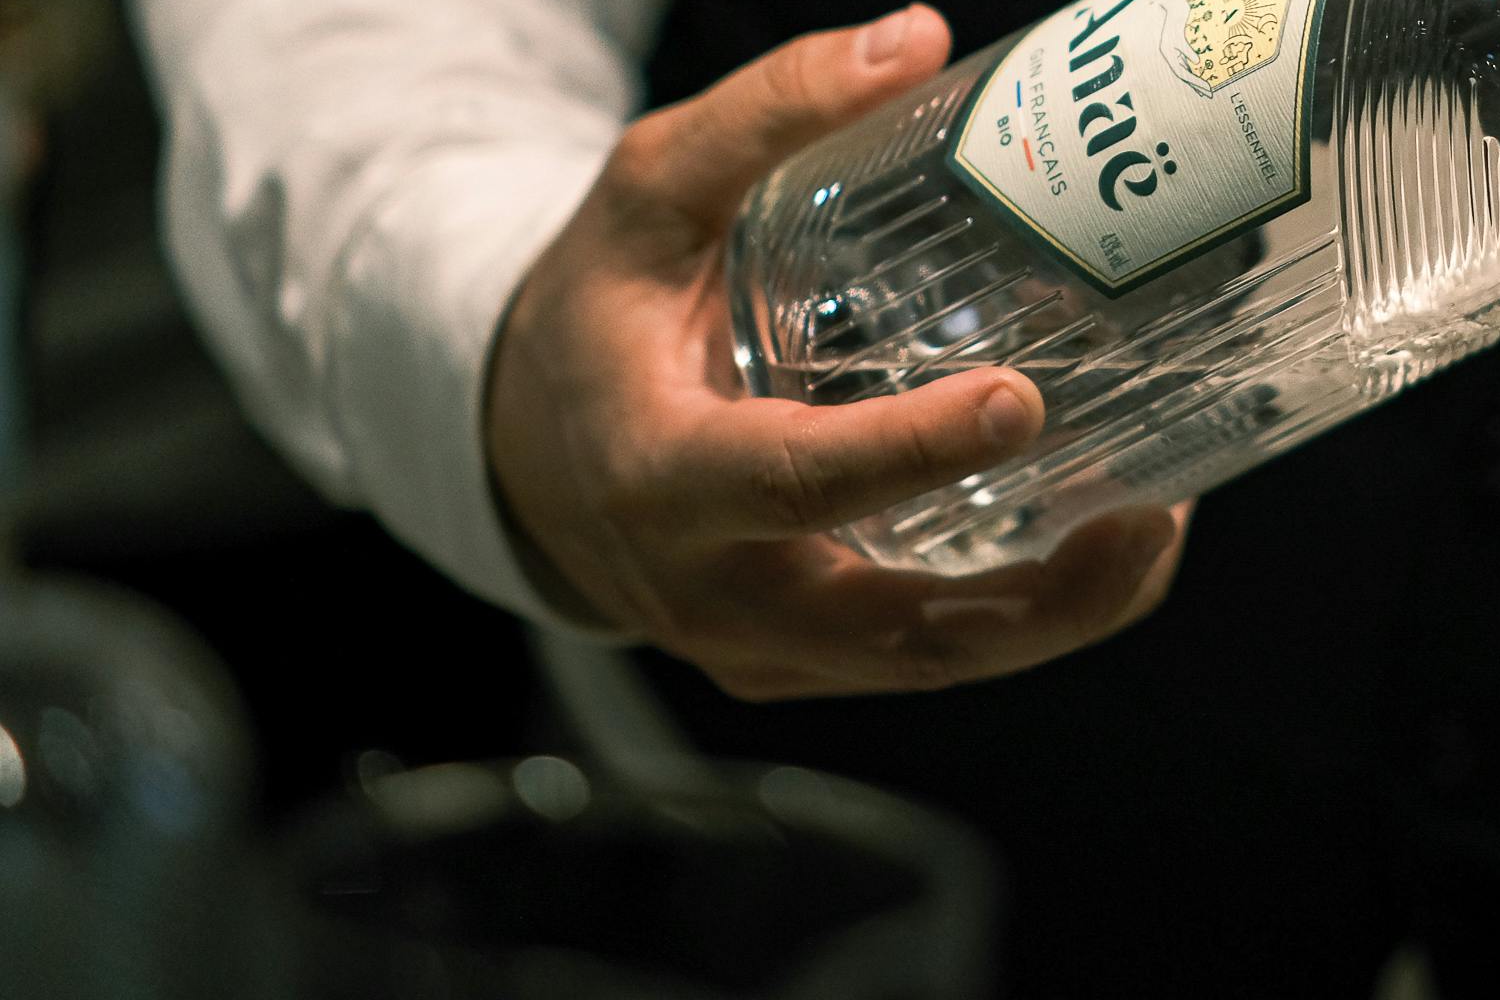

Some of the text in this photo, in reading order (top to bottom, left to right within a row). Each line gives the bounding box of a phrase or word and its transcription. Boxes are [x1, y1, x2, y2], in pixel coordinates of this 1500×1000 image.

[995, 113, 1014, 148] BIO
[1027, 46, 1068, 198] GIN FRANÇAIS
[1229, 91, 1277, 186] L'ESSENTIEL
